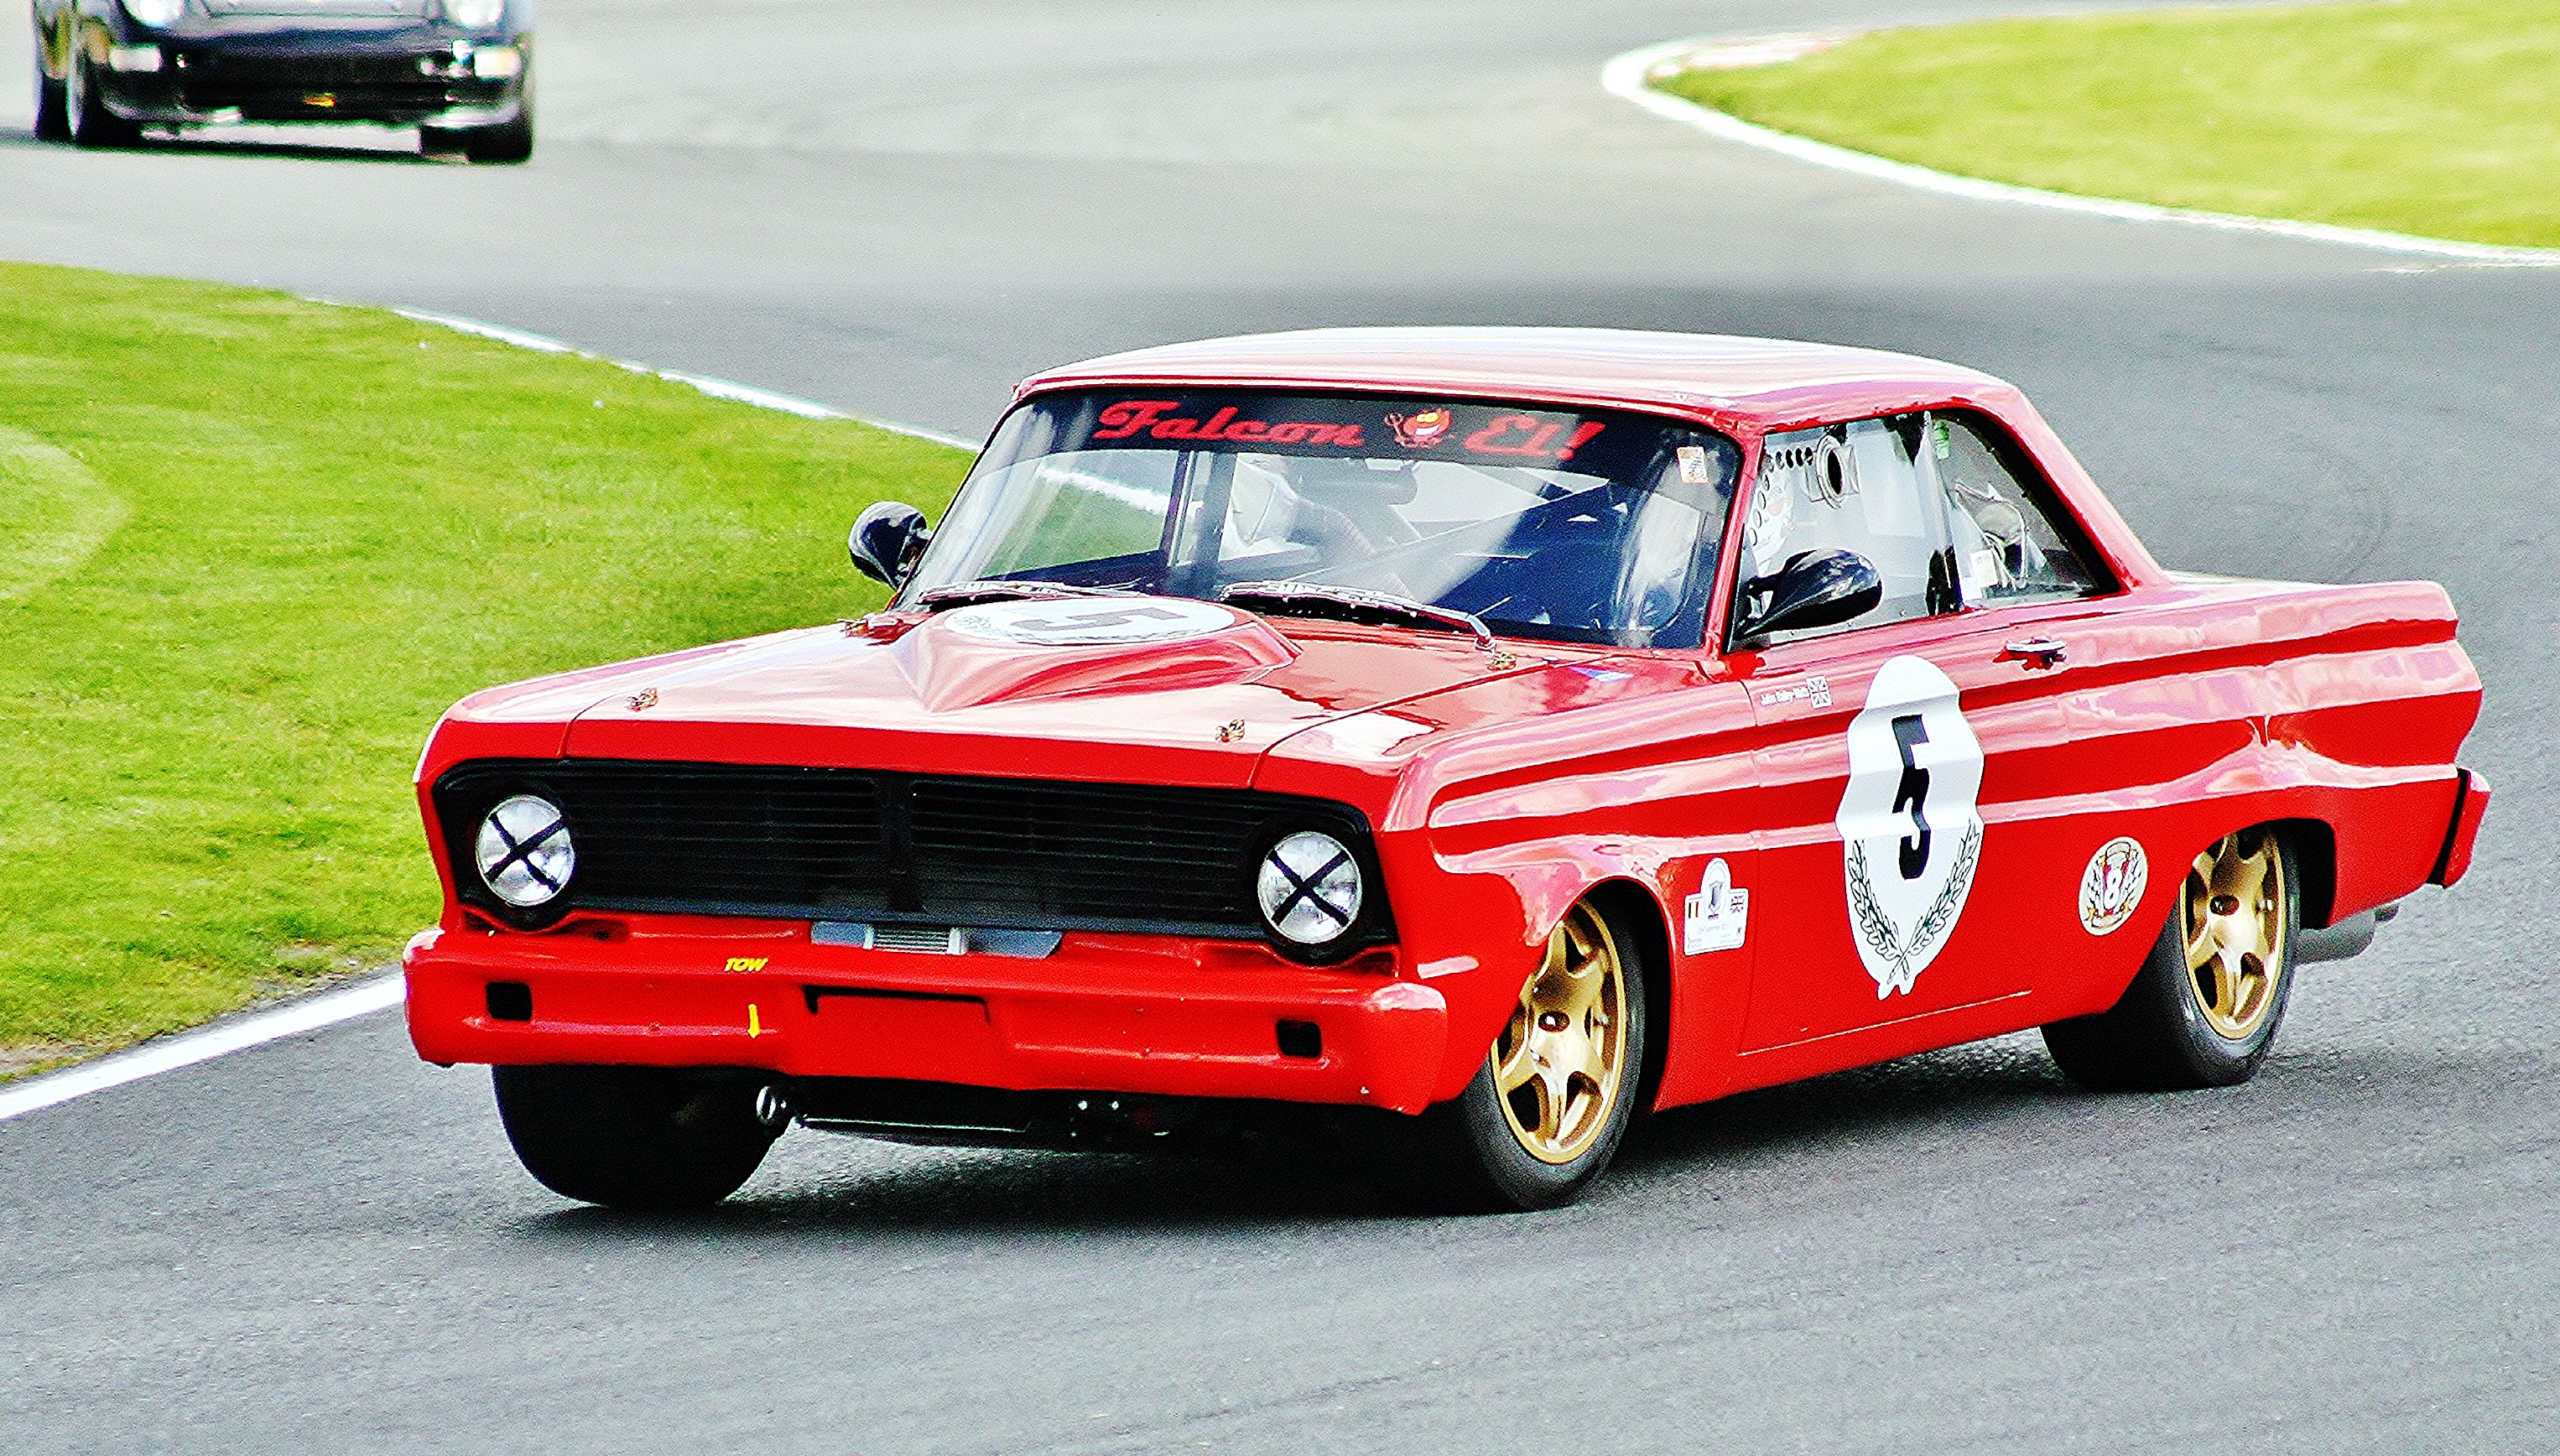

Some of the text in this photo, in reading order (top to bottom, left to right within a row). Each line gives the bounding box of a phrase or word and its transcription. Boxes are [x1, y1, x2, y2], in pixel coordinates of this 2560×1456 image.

[1092, 400, 1606, 461] Falcon El!
[1009, 606, 1189, 632] 5
[1891, 714, 1931, 880] 5
[724, 957, 769, 972] TOW
